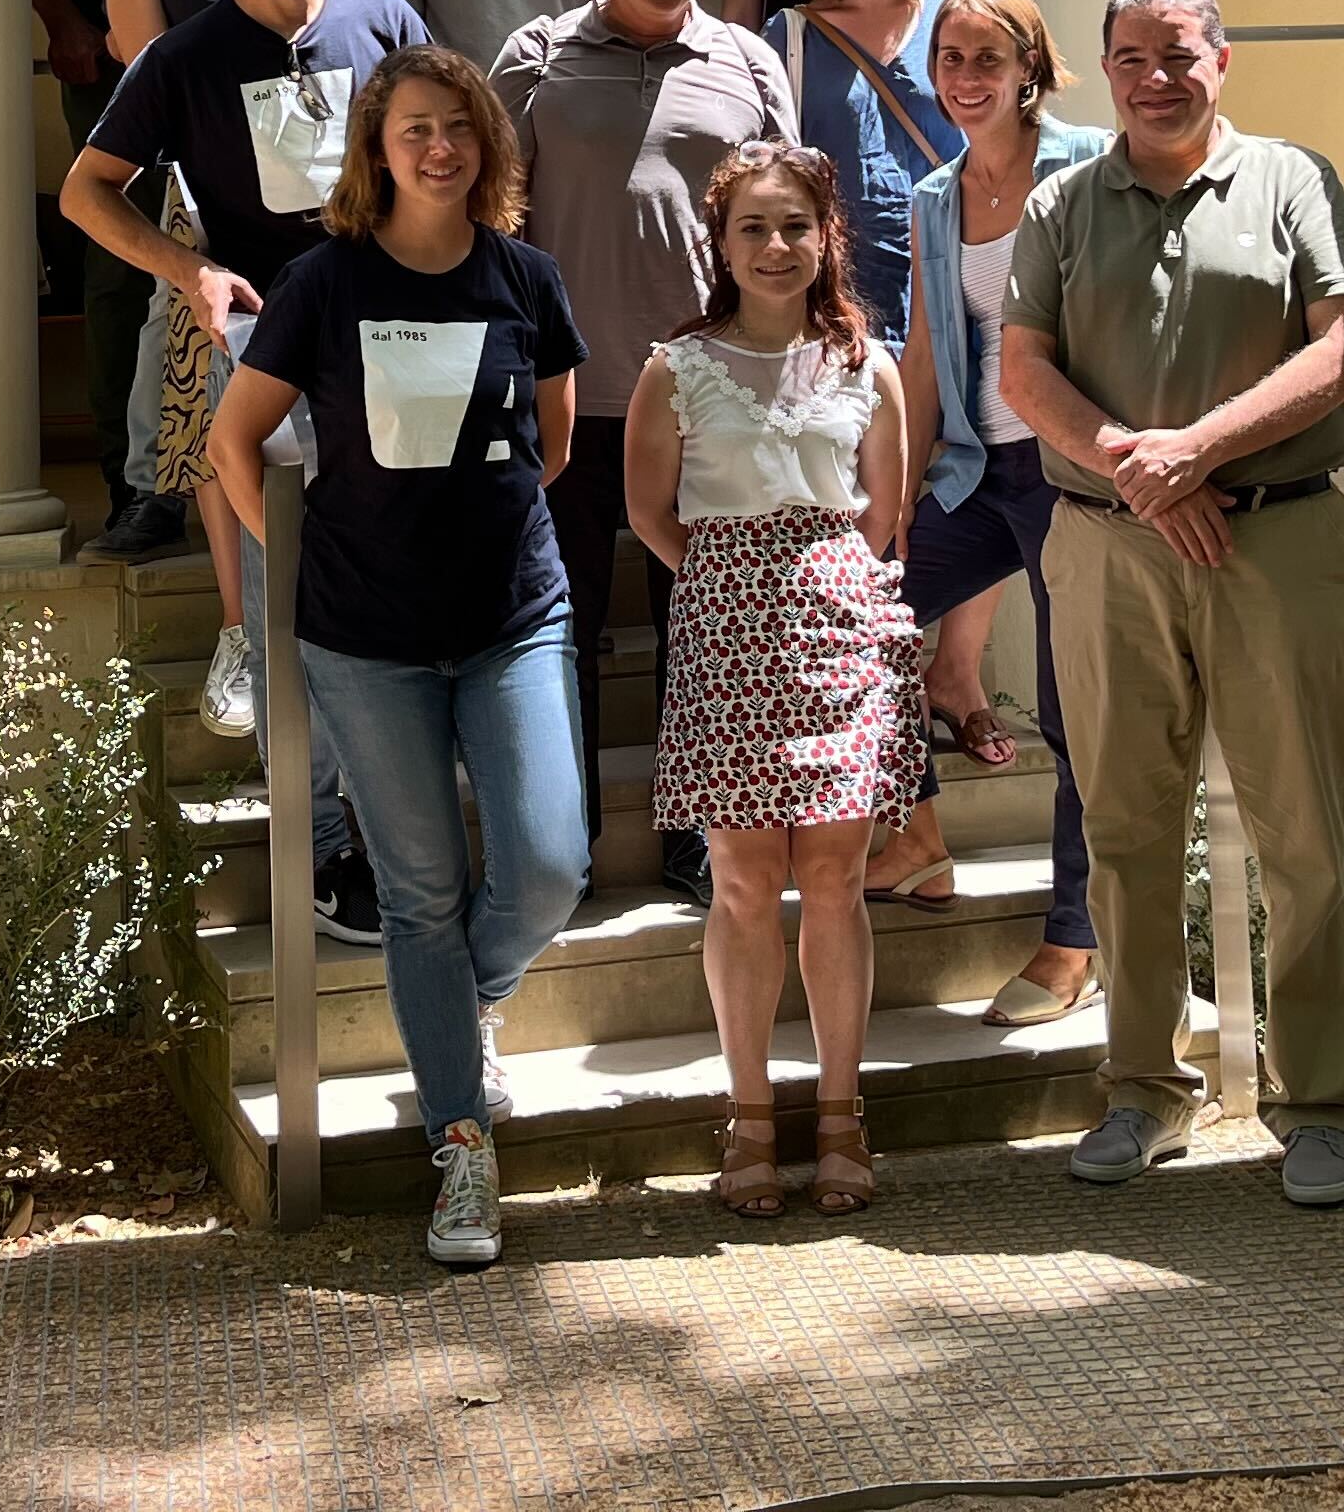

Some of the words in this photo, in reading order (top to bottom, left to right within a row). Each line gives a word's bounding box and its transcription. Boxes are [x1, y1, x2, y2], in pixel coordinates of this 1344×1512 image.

[252, 89, 272, 101] dal
[371, 331, 391, 341] dal
[396, 330, 428, 342] 1985
